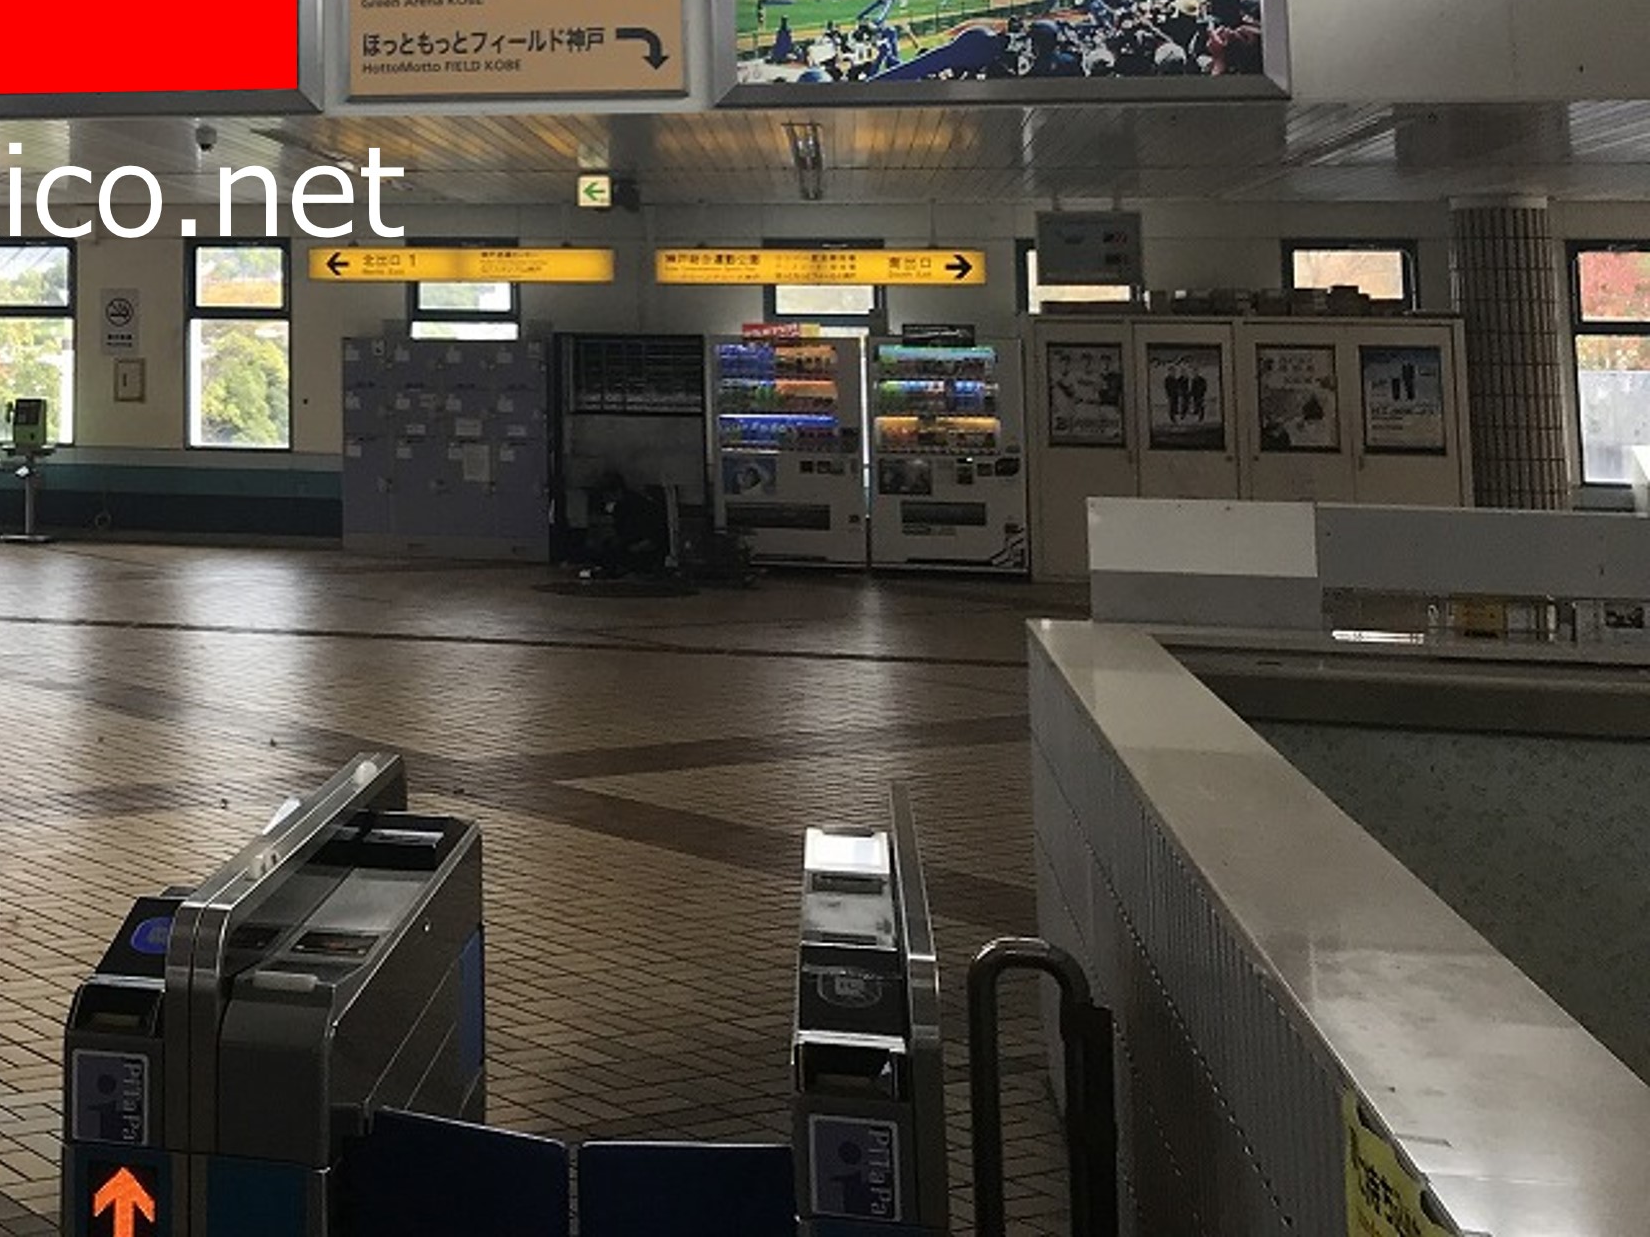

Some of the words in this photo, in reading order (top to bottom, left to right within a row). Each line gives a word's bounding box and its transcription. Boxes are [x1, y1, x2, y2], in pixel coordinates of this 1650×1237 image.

[362, 27, 606, 57] ほっともっとフィールド神戸
[362, 61, 442, 74] HottoMotto
[444, 60, 482, 72] FIELD
[484, 59, 522, 72] KOBE
